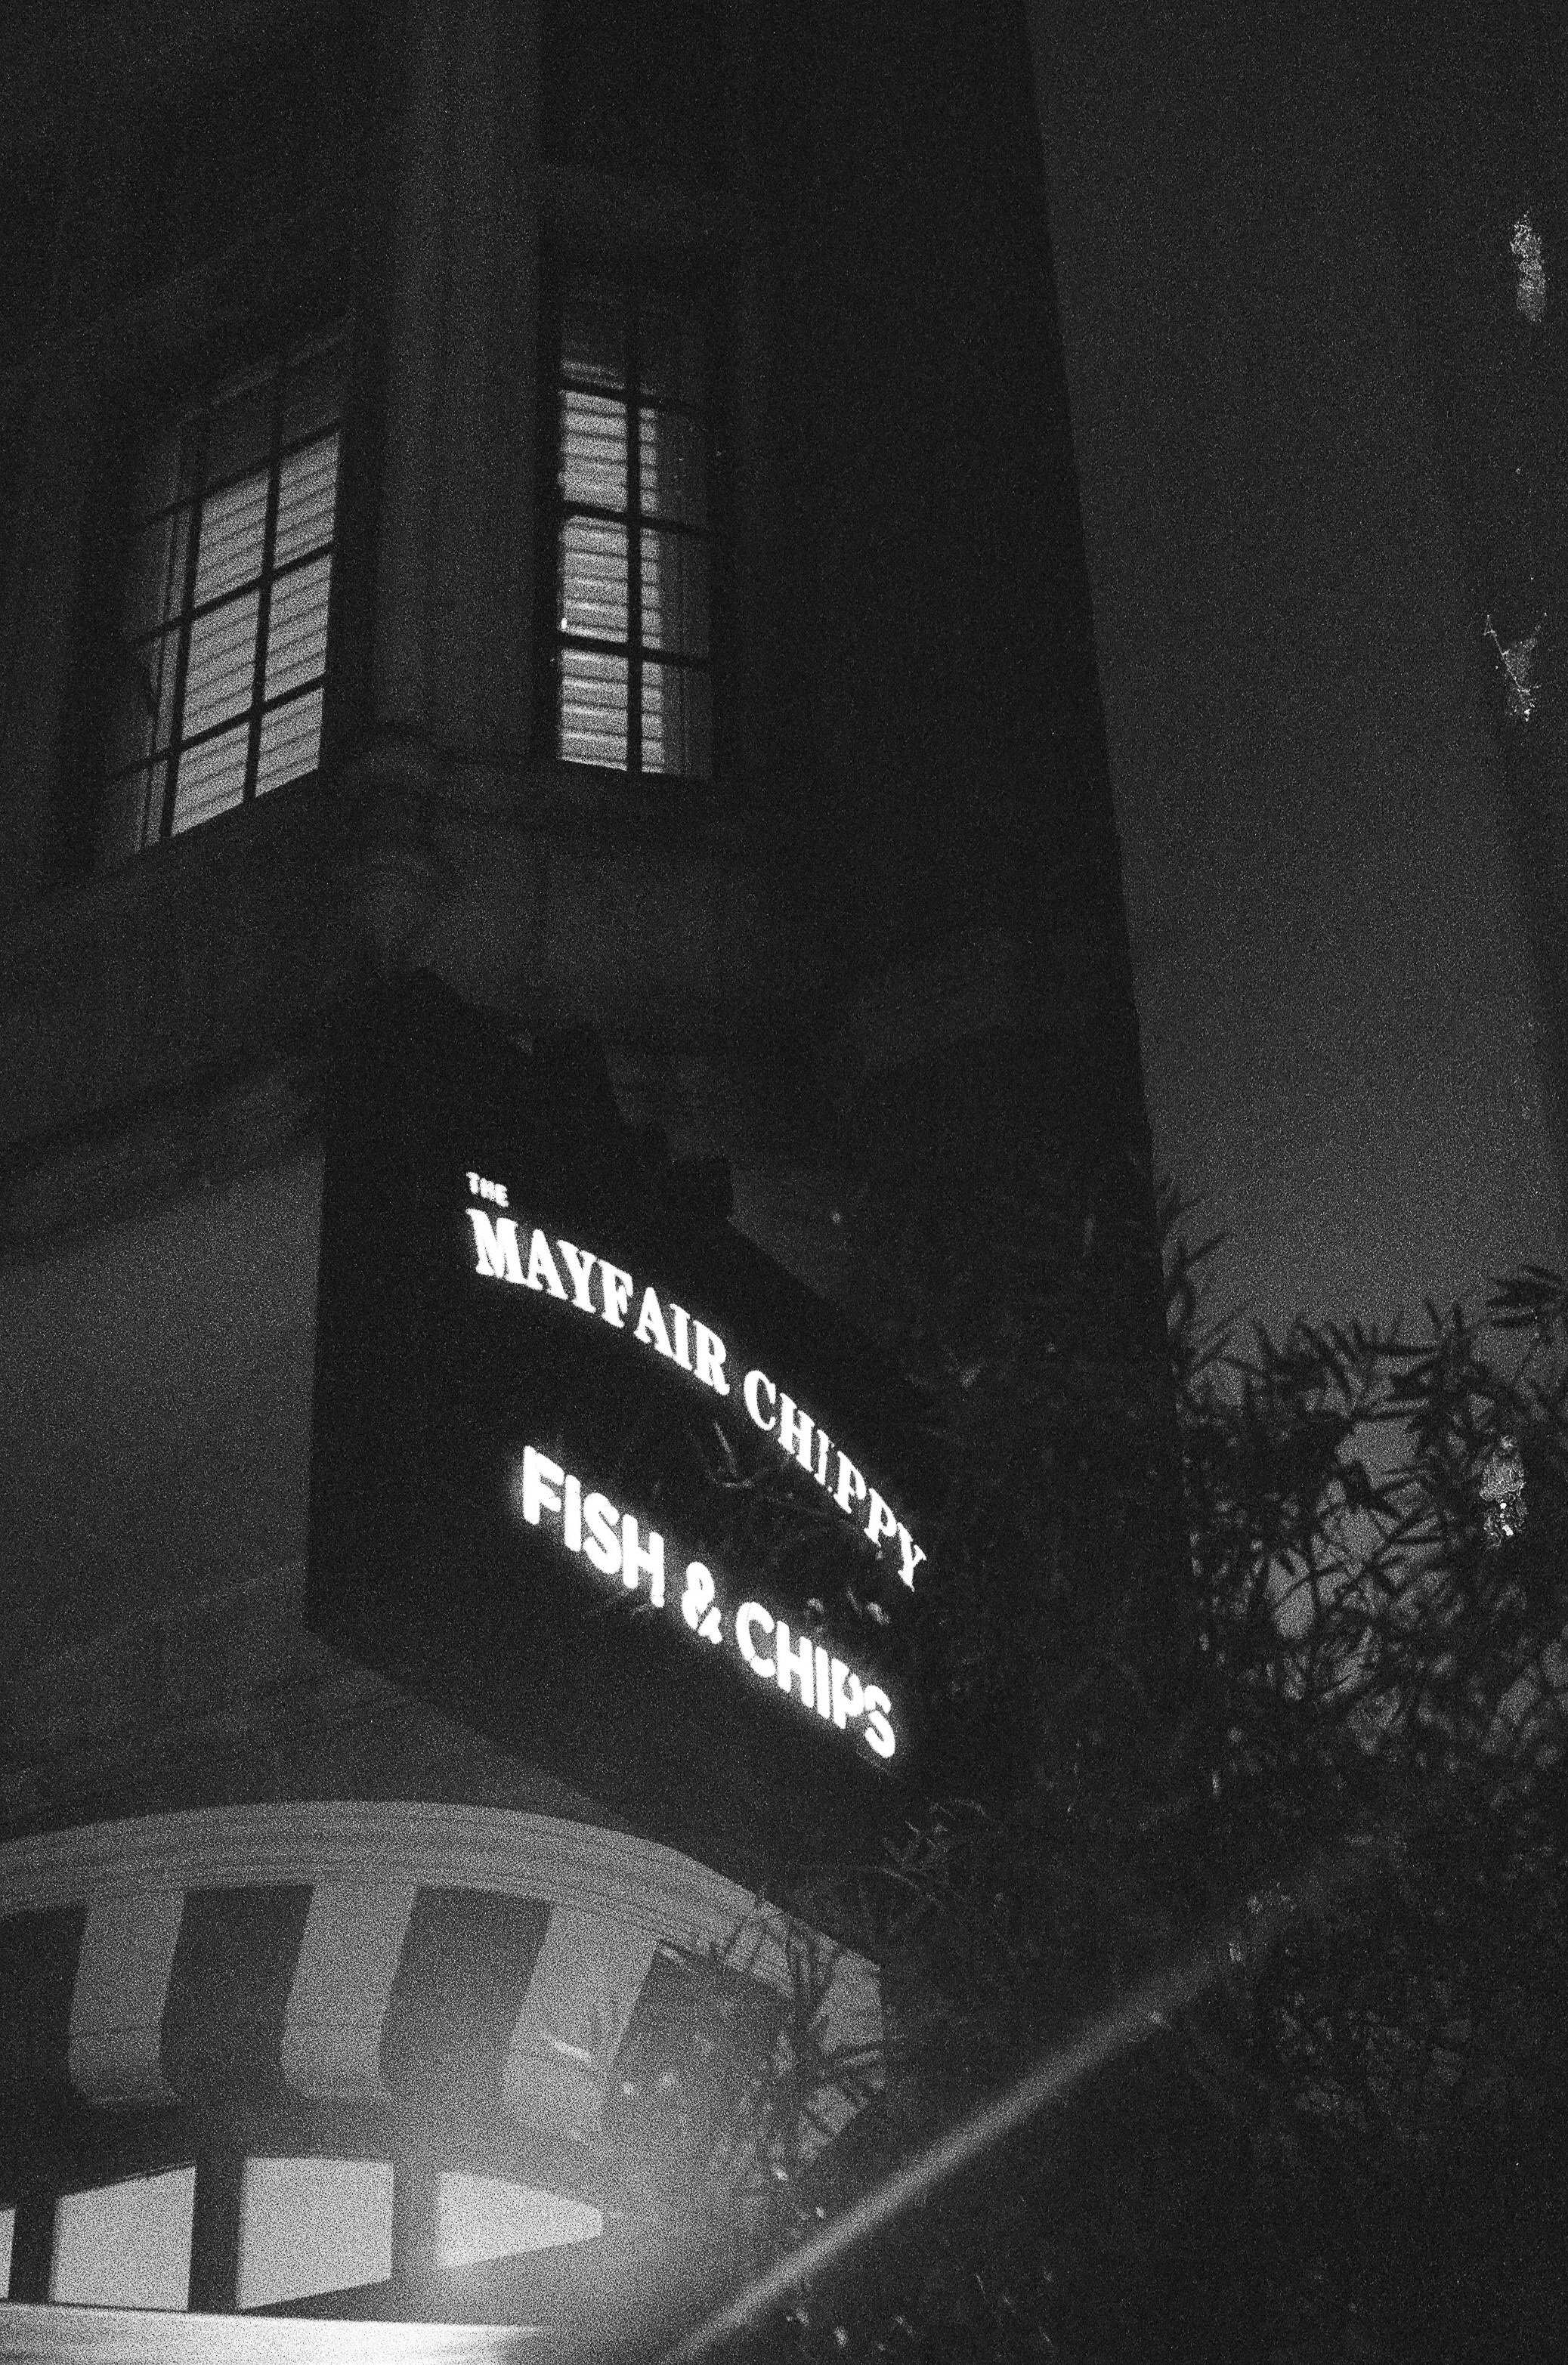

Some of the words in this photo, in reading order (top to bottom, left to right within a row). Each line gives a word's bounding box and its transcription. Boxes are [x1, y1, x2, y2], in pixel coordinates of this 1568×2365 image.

[466, 1172, 509, 1207] THE
[466, 1208, 731, 1396] MAYFAIR
[744, 1369, 927, 1592] CHIPPY
[520, 1445, 665, 1608] FISH
[679, 1561, 722, 1645] &
[735, 1601, 896, 1759] CHIPS
